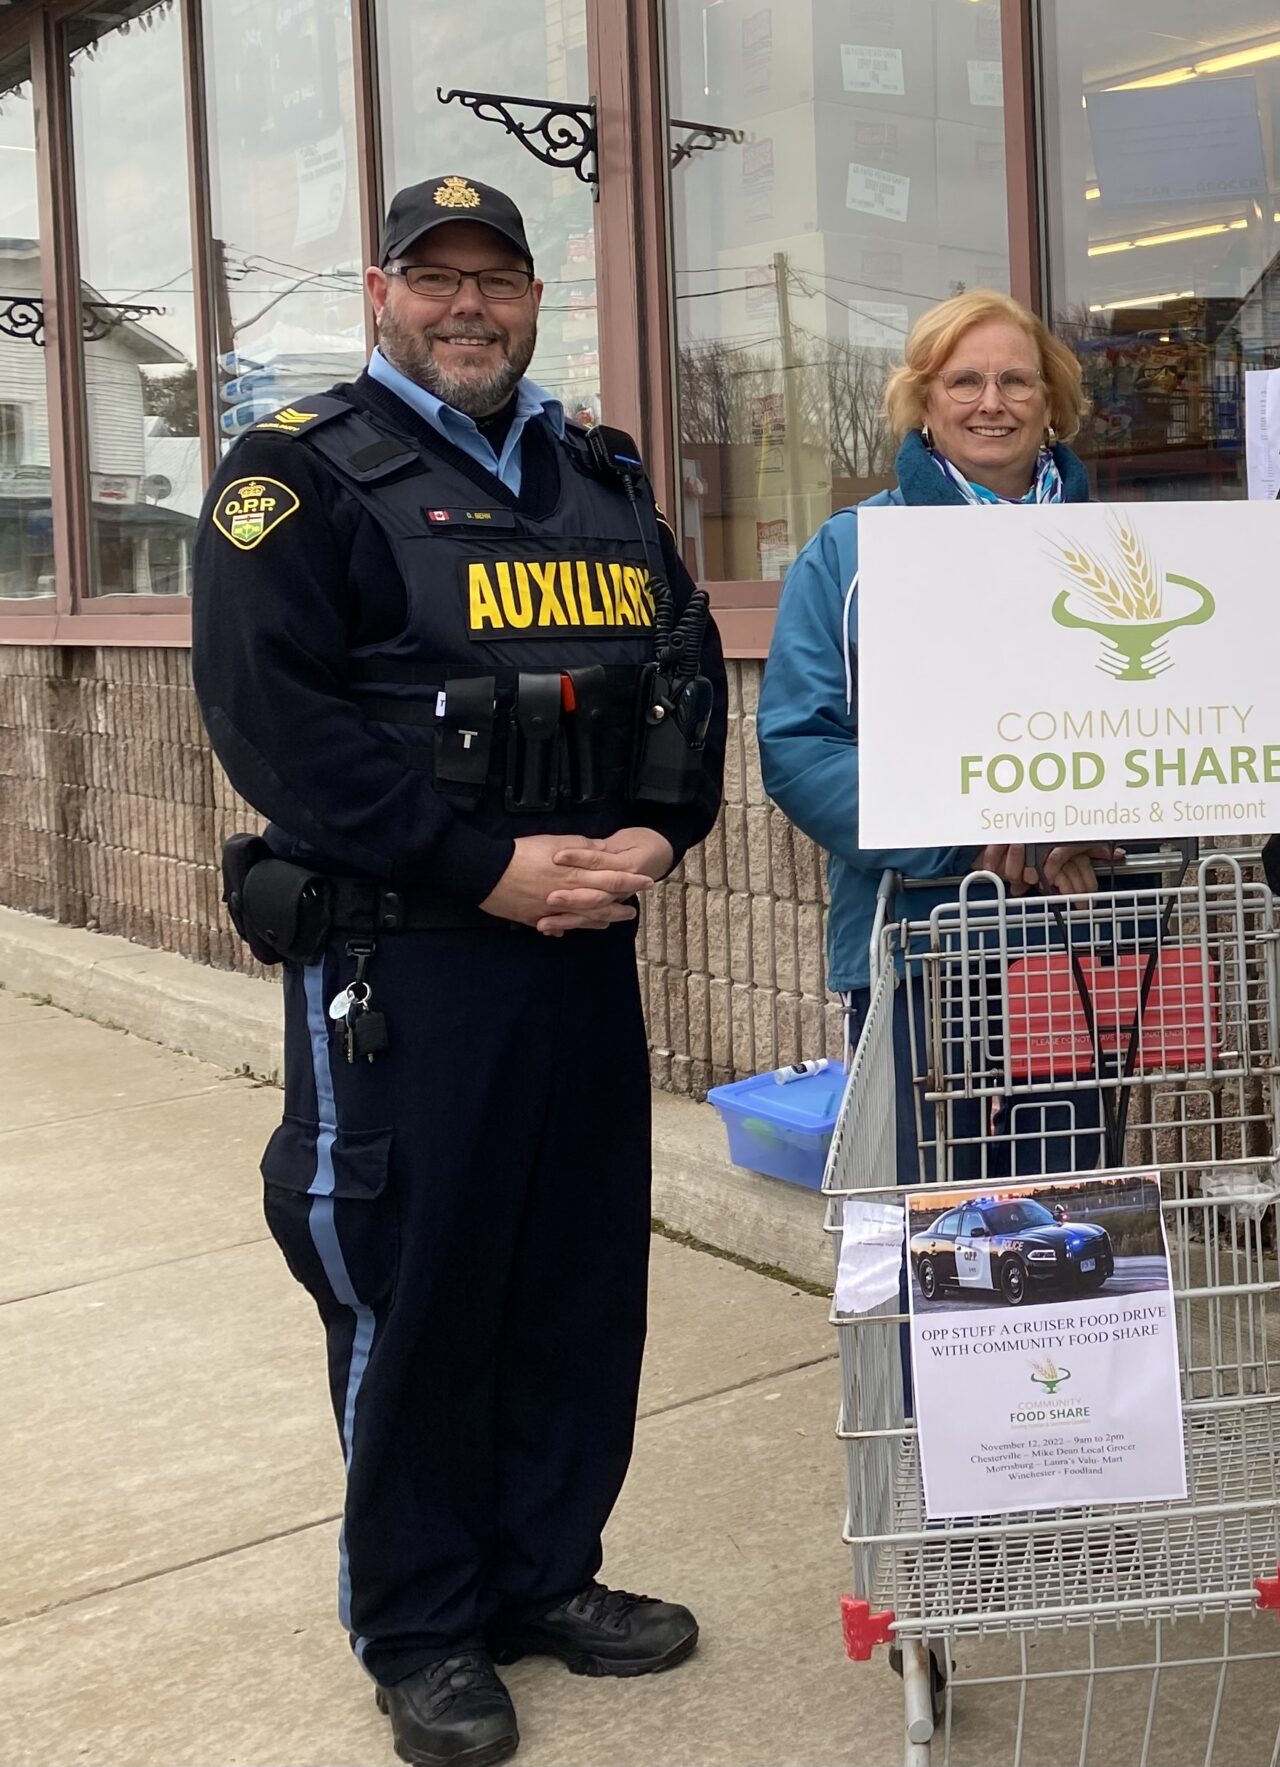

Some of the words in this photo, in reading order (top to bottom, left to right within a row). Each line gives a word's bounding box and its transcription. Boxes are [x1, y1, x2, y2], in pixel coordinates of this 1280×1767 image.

[225, 498, 276, 515] O.P.P.
[997, 705, 1254, 742] COMMUNITY
[961, 752, 1105, 794] FOOD
[981, 807, 1055, 833] Serving
[1065, 802, 1143, 826] Dundas
[1149, 802, 1163, 822] &
[1173, 800, 1266, 821] Stormont
[1032, 1037, 1060, 1046] PLEAE
[1001, 1240, 1024, 1252] POLICE
[964, 1252, 978, 1261] OPP
[922, 1328, 949, 1340] OPP
[952, 1325, 996, 1339] STUFF
[1000, 1324, 1010, 1335] A
[1014, 1318, 1075, 1334] CRUISER
[1080, 1314, 1119, 1328] FOOD
[1123, 1306, 1167, 1322] DRIVE
[931, 1344, 969, 1357] WITH
[973, 1336, 1064, 1354] COMMUNITY
[1069, 1332, 1109, 1346] FOOD
[1112, 1324, 1159, 1341] SHARE
[1018, 1398, 1082, 1410] COMMUNITY
[1010, 1410, 1046, 1422] FOOD
[1049, 1407, 1090, 1419] SHARE
[980, 1442, 1024, 1451] November
[1043, 1438, 1064, 1446] 2022
[1074, 1436, 1092, 1444] 9am
[1106, 1433, 1124, 1442] 2pm
[970, 1452, 1022, 1464] Chesterville
[1032, 1450, 1054, 1458] Mike
[1056, 1448, 1079, 1456] Dean
[1081, 1446, 1104, 1454] Local
[1106, 1444, 1136, 1452] Grocer
[986, 1462, 1034, 1474] Morrisburg
[1102, 1456, 1123, 1464] Mart
[1008, 1470, 1056, 1480] Winchester
[1064, 1467, 1103, 1475] Foodland
